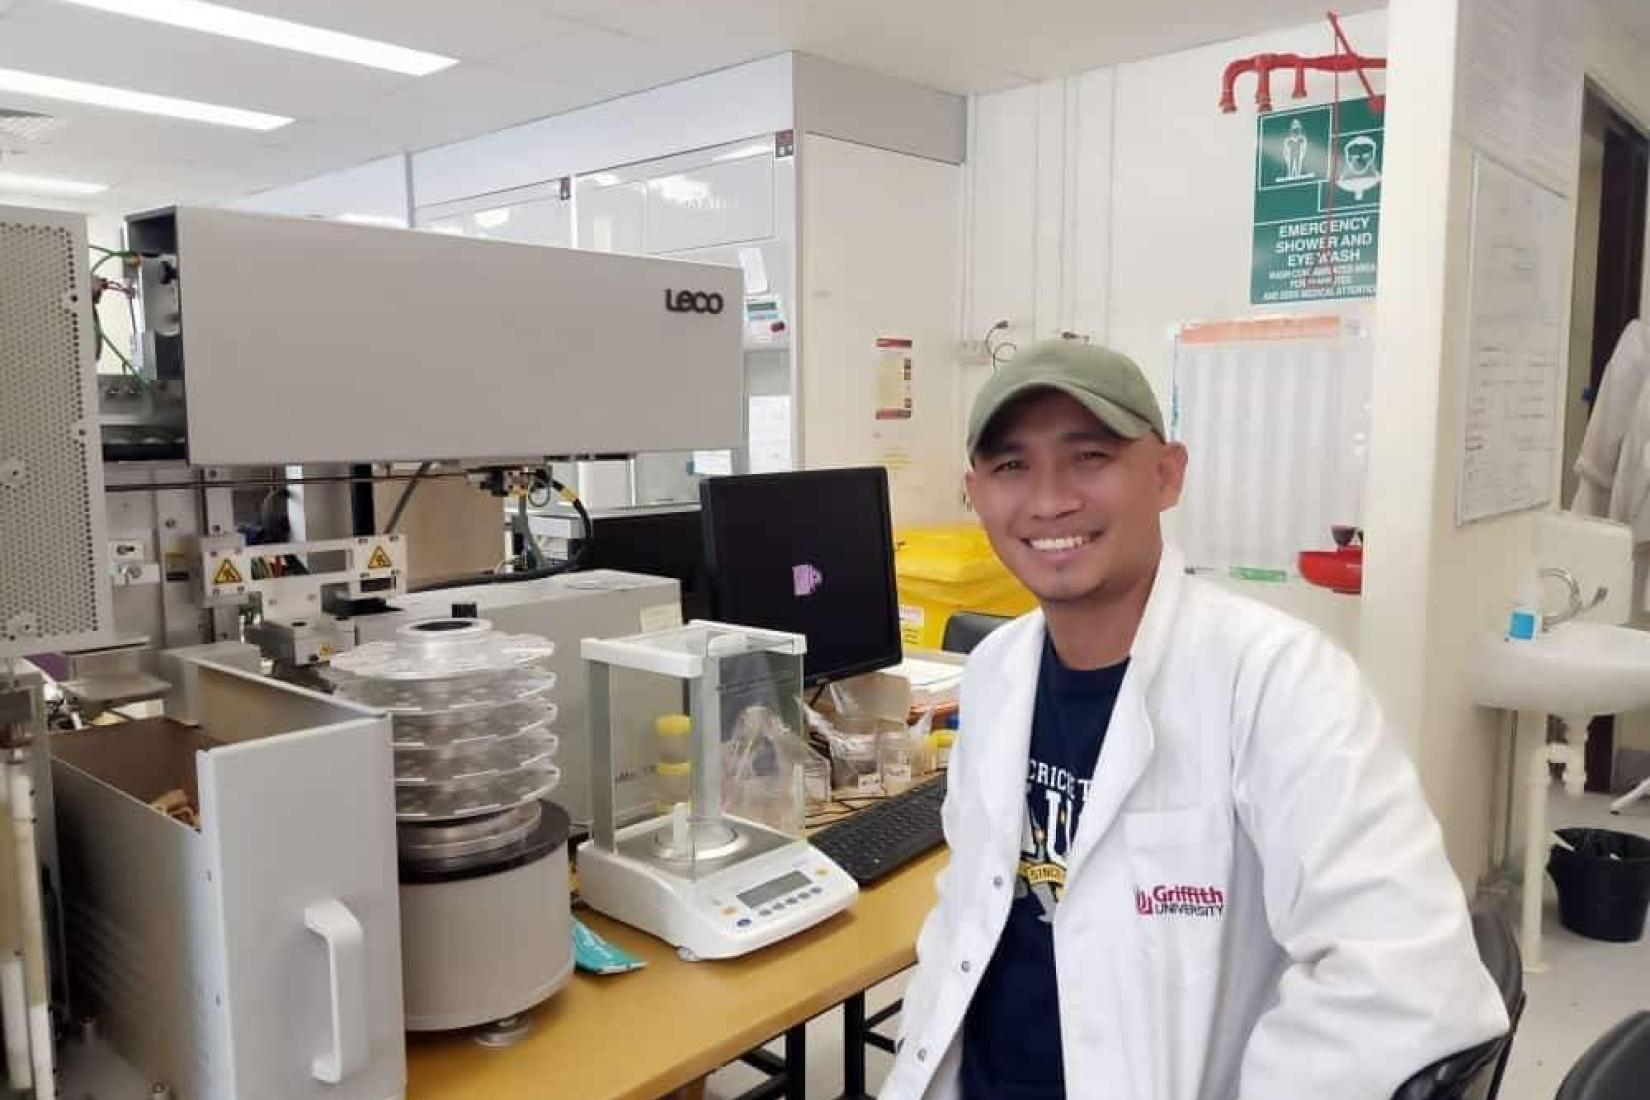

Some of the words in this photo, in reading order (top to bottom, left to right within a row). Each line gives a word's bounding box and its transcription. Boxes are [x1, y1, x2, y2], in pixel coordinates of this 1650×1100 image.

[1279, 216, 1370, 237] EMERGENCY
[1275, 236, 1338, 254] SHOWER
[1340, 233, 1372, 247] AND
[1287, 253, 1316, 267] EYE
[1153, 885, 1223, 904] Griffith
[1155, 902, 1224, 917] UNIVERSITY
